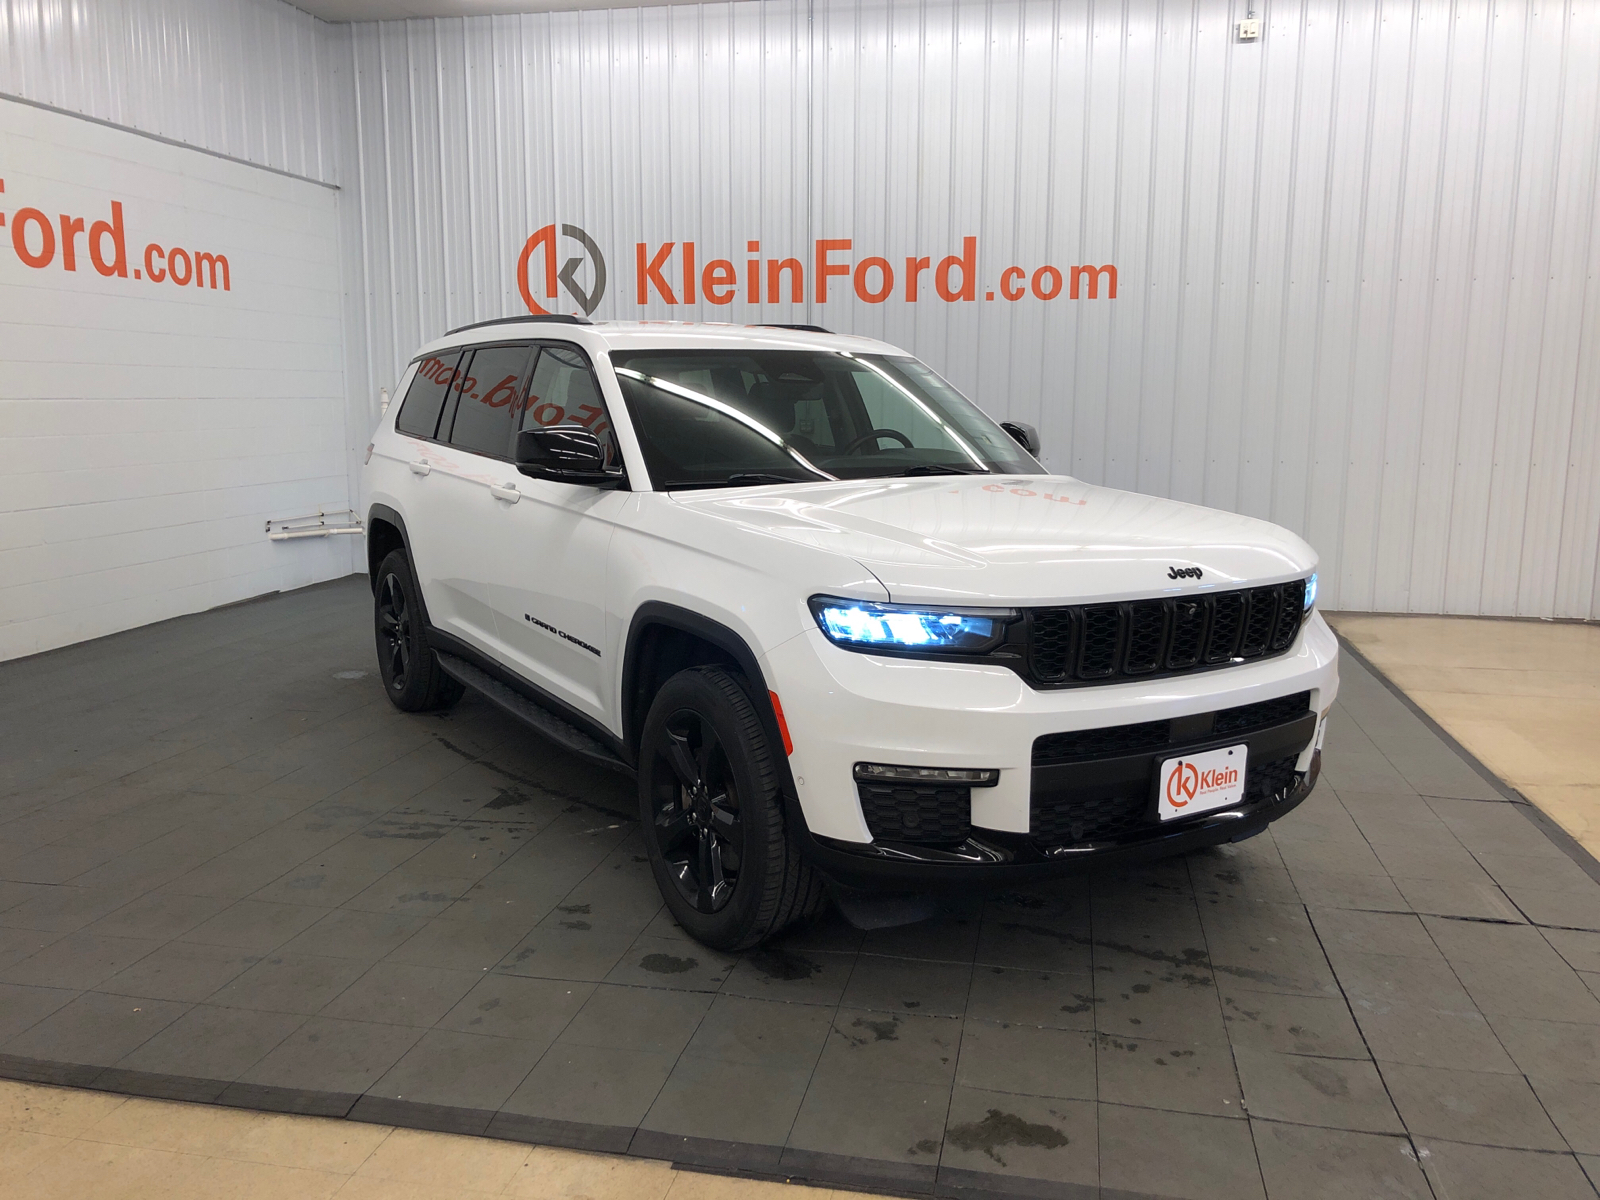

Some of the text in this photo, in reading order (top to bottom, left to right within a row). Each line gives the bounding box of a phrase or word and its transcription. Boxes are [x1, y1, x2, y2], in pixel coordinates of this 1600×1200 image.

[636, 236, 1118, 305] KleinFord.com
[1167, 566, 1203, 580] Jeep
[531, 617, 602, 657] GRAND CHEROKEE
[1200, 766, 1238, 790] Klein
